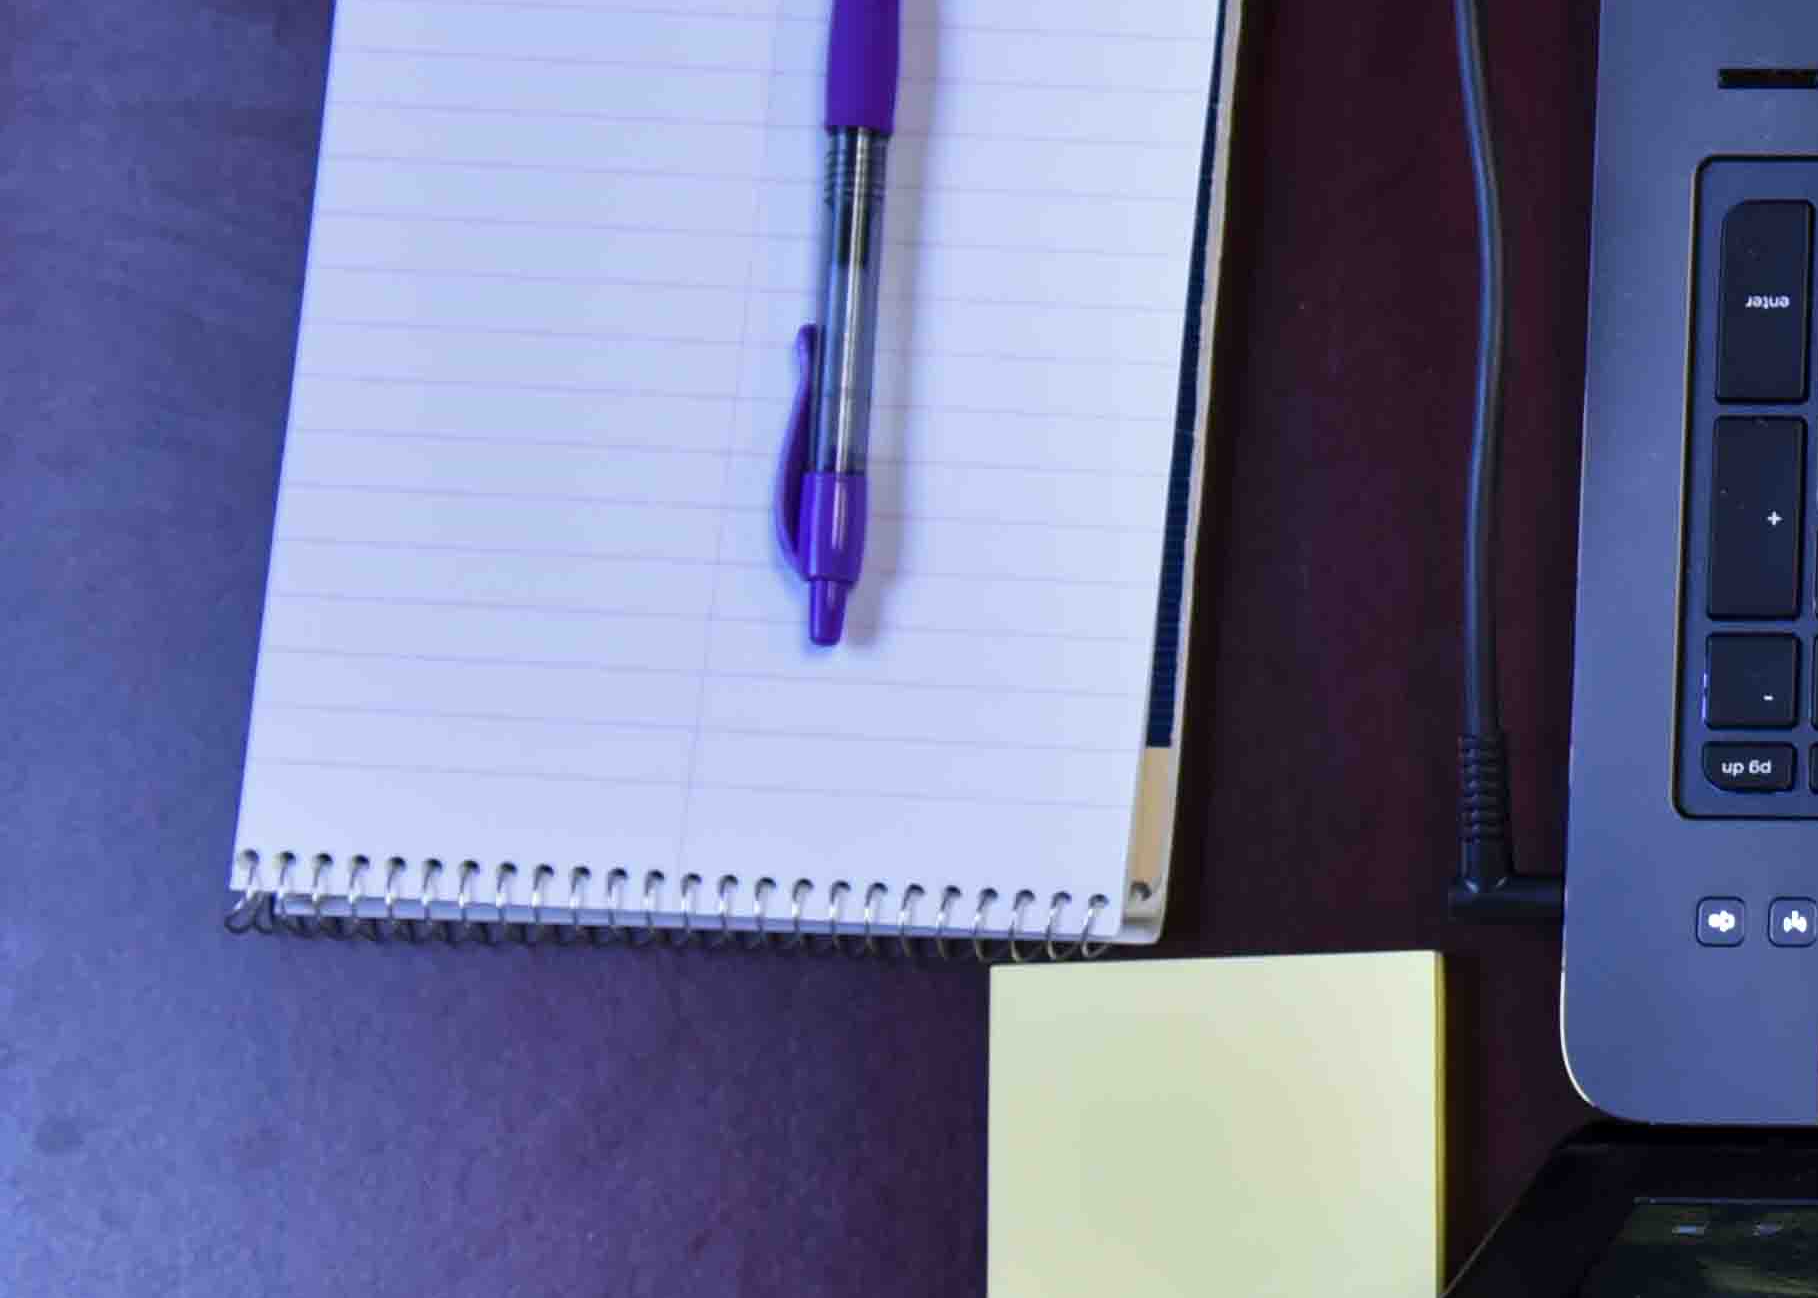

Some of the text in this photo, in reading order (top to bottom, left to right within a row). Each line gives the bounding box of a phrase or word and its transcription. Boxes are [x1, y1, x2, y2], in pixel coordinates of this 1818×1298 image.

[1745, 295, 1790, 310] enter
[1721, 759, 1772, 777] pg dn
